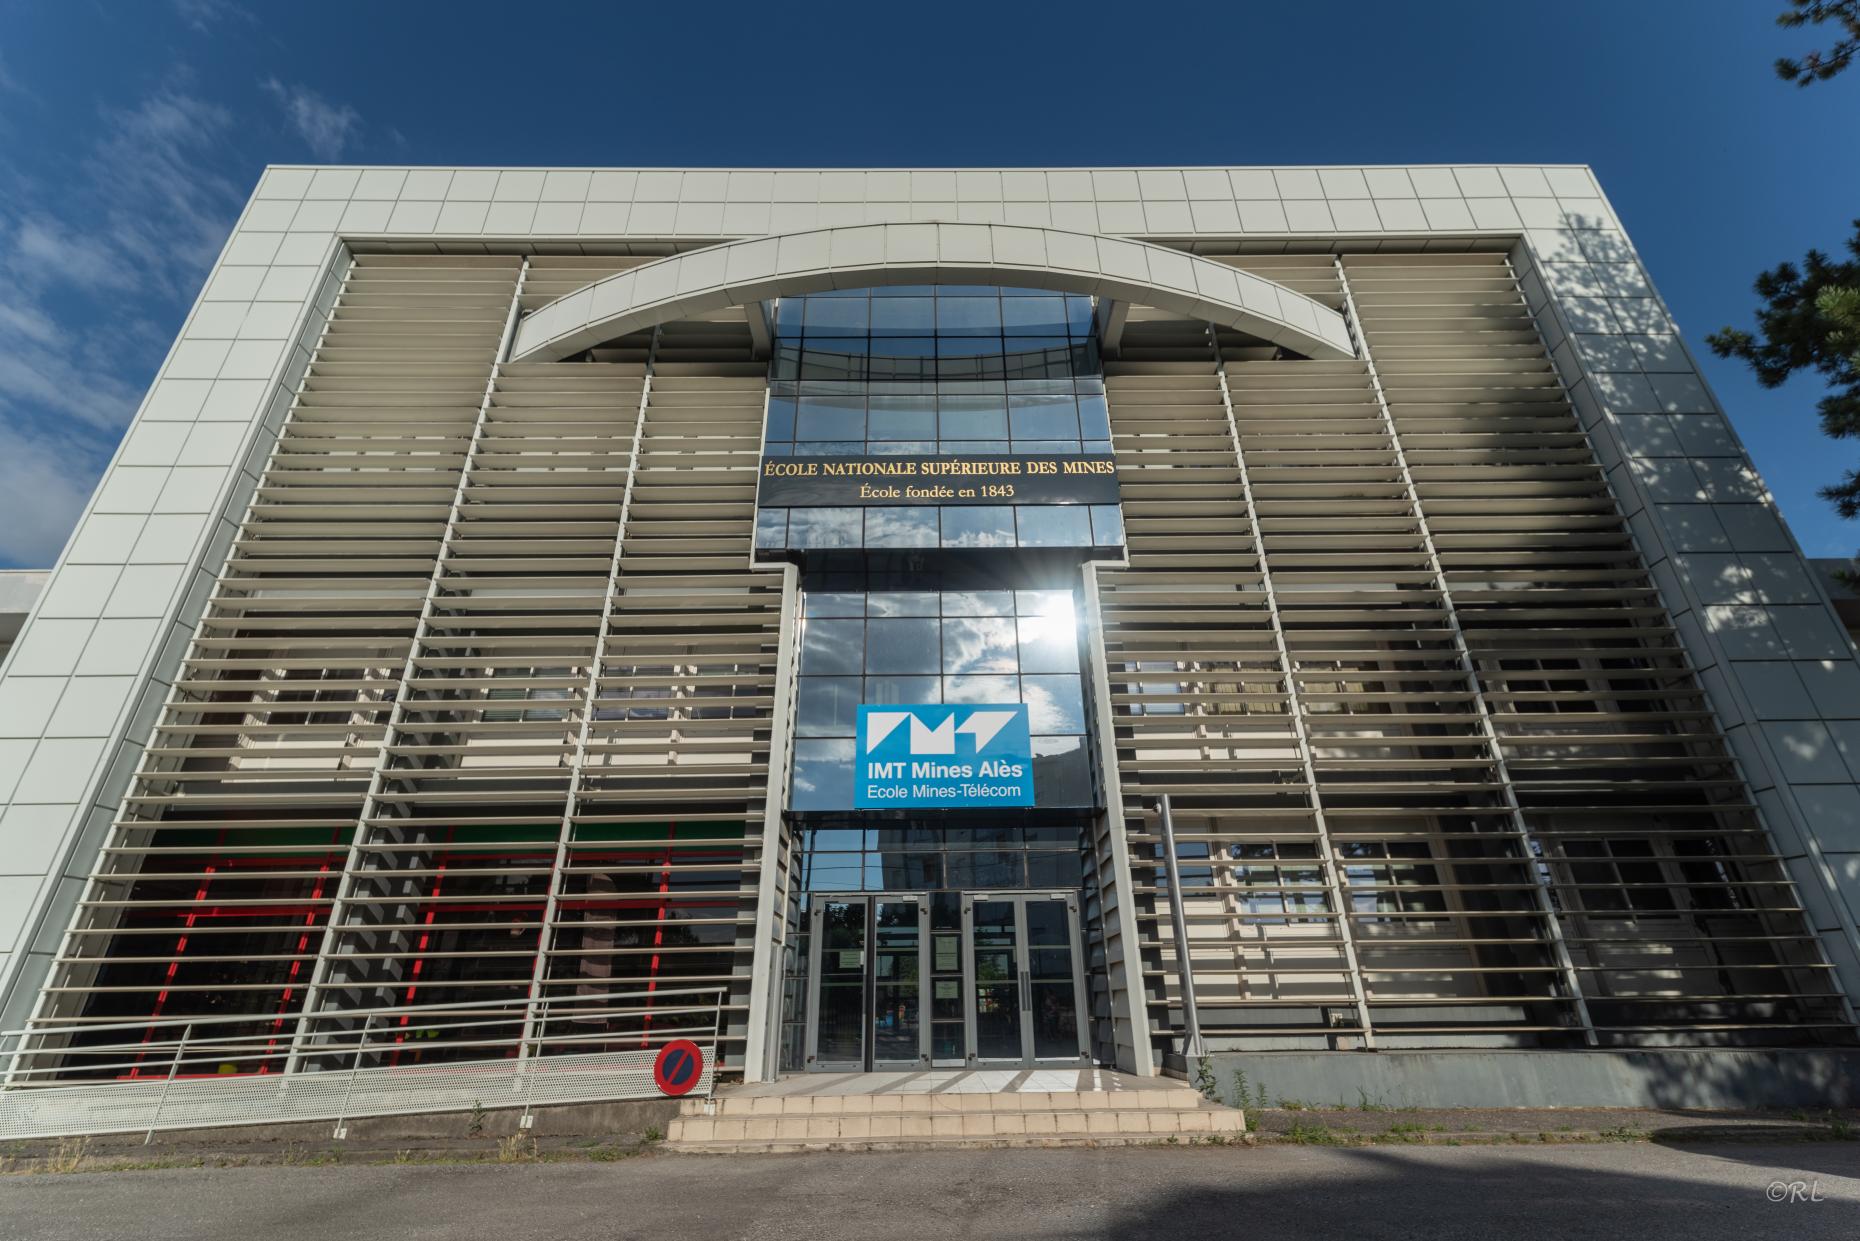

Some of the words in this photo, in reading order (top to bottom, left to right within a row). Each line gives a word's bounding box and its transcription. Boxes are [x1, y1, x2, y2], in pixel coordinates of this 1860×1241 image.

[764, 460, 817, 476] ÉCOLE
[822, 462, 916, 475] NATIONALE
[921, 459, 1020, 475] SUPÉRIEURE
[1026, 462, 1057, 474] DES
[1063, 461, 1114, 474] MINES
[860, 483, 900, 498] École
[906, 485, 954, 498] fondée
[958, 489, 975, 498] en
[980, 485, 1015, 497] 1843
[868, 762, 906, 779] IMT
[911, 762, 973, 778] Mines
[978, 759, 1023, 777] Alès
[867, 785, 908, 798] Ecole
[912, 783, 1021, 797] Mines-Télécom
